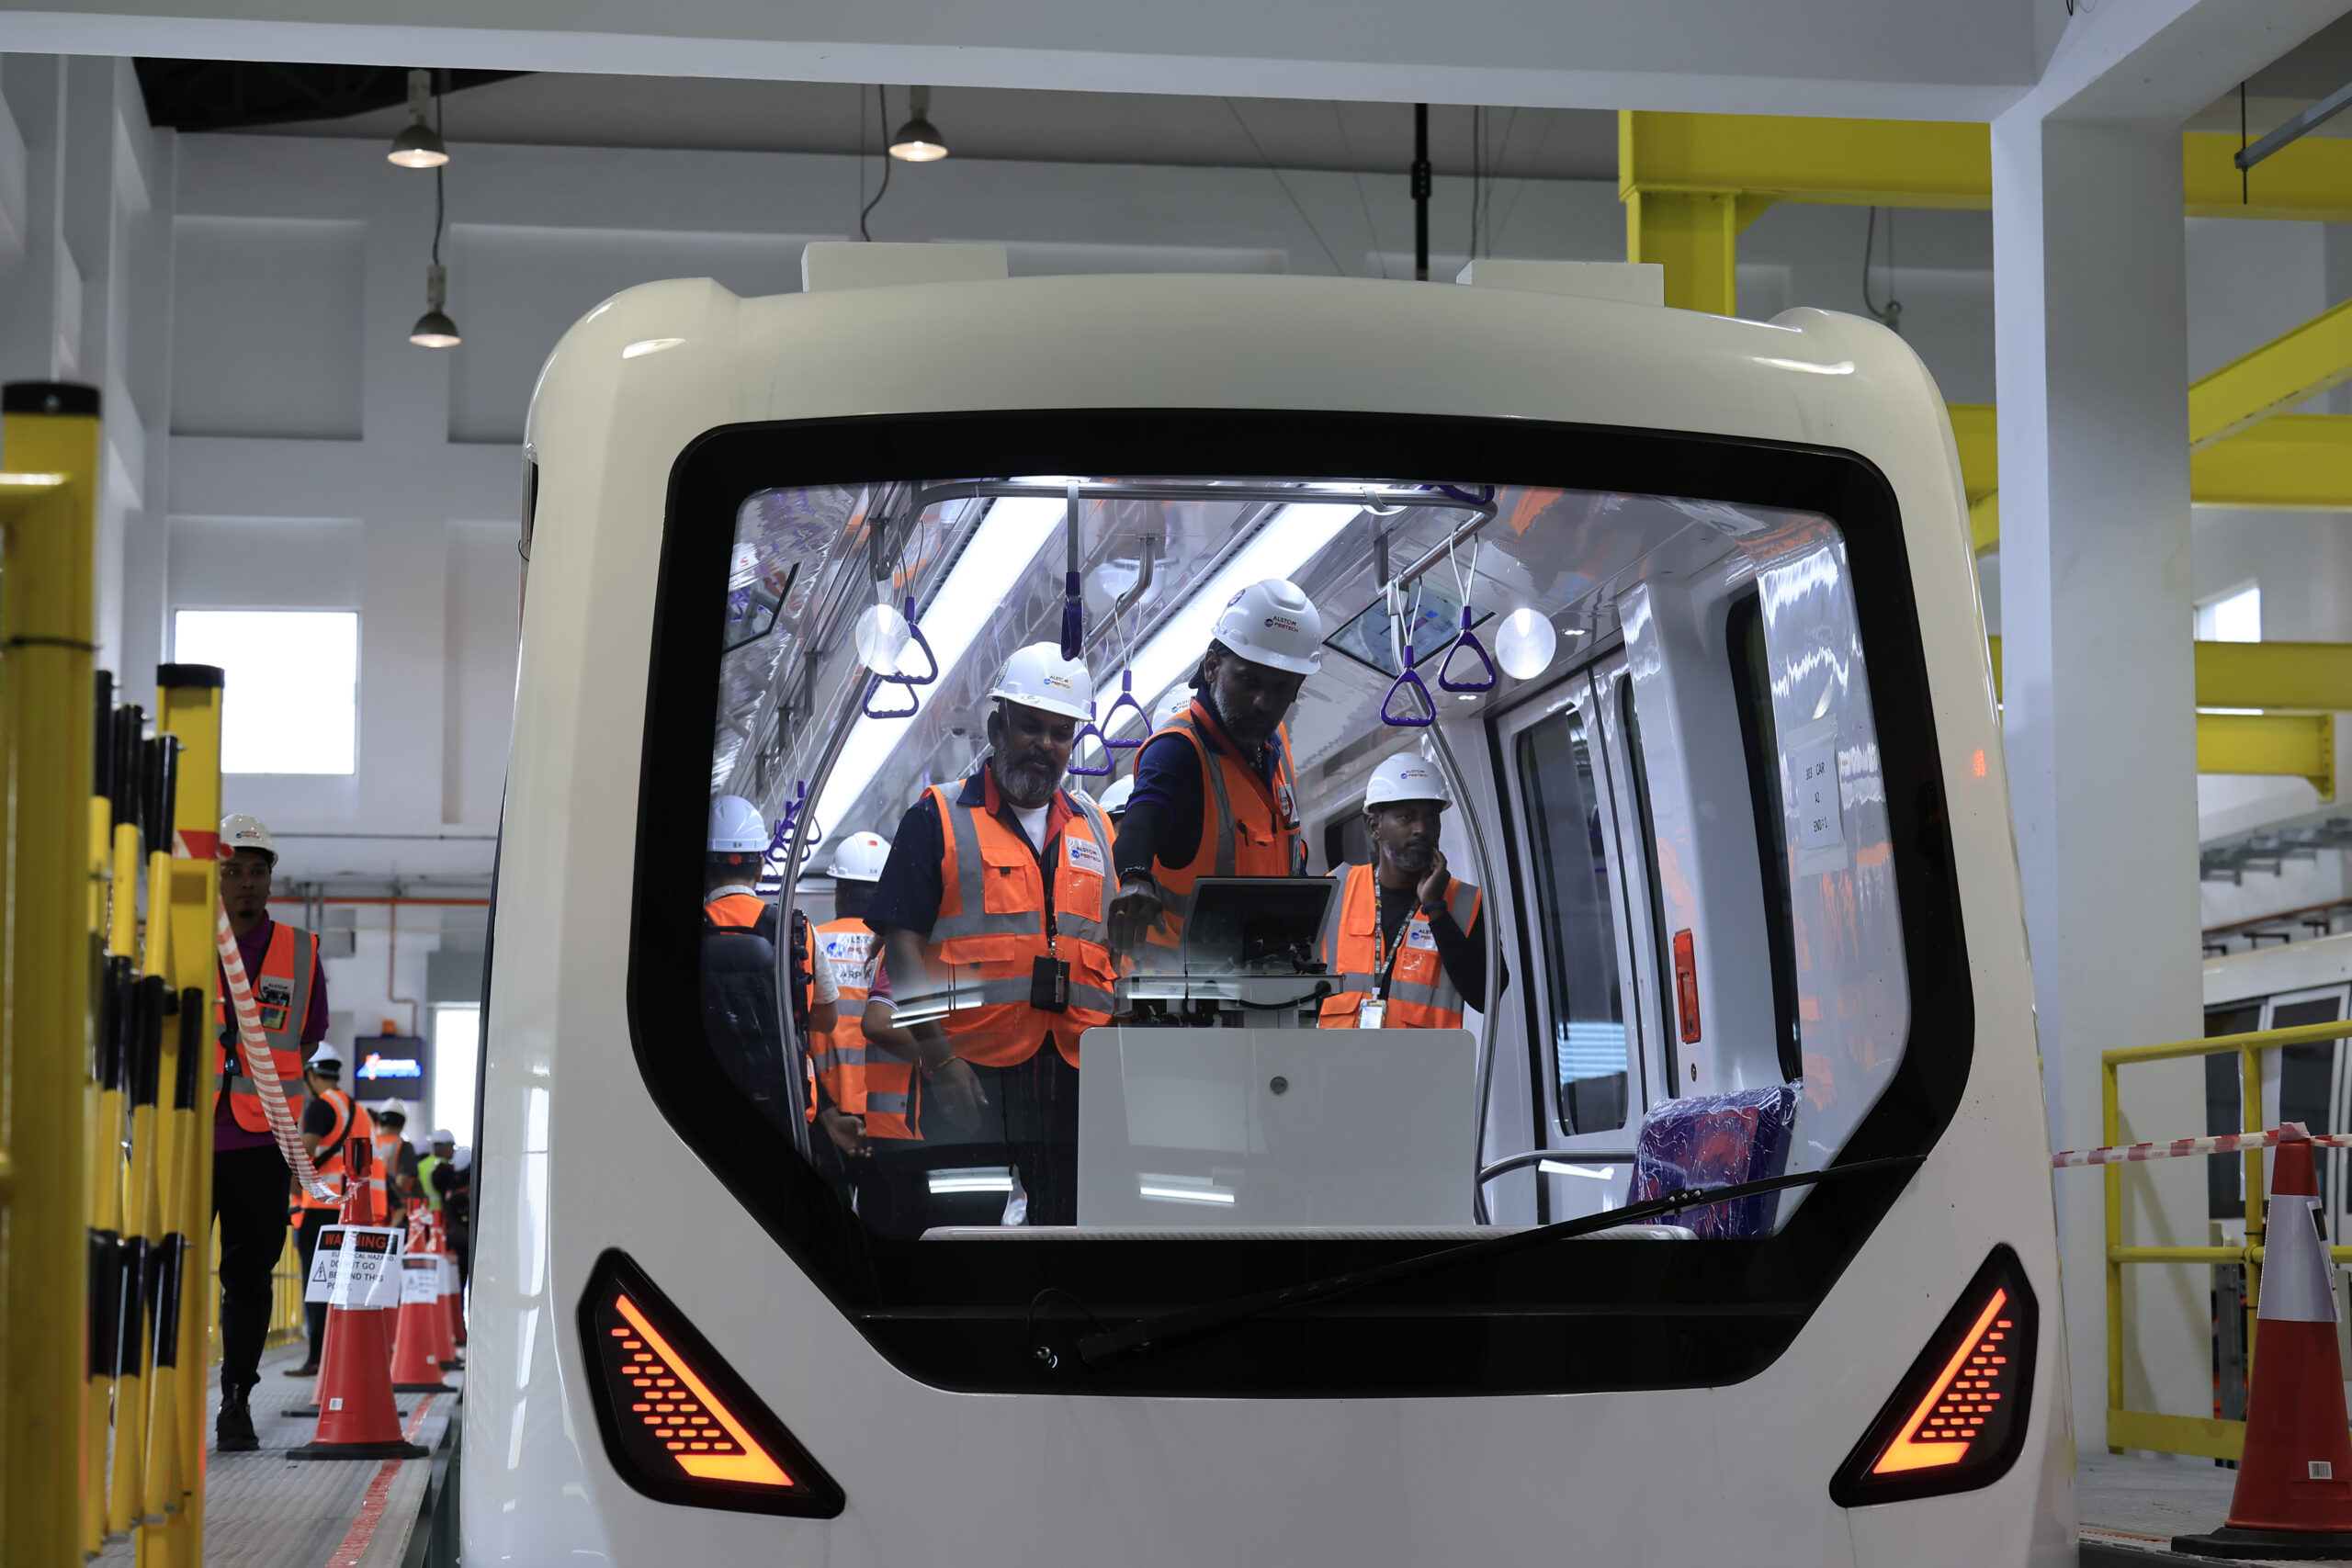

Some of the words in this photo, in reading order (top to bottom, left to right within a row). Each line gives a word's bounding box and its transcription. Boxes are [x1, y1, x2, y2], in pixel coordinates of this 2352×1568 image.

[1273, 615, 1296, 626] ALSTOM
[1815, 761, 1825, 775] CAR
[362, 1262, 376, 1270] GO
